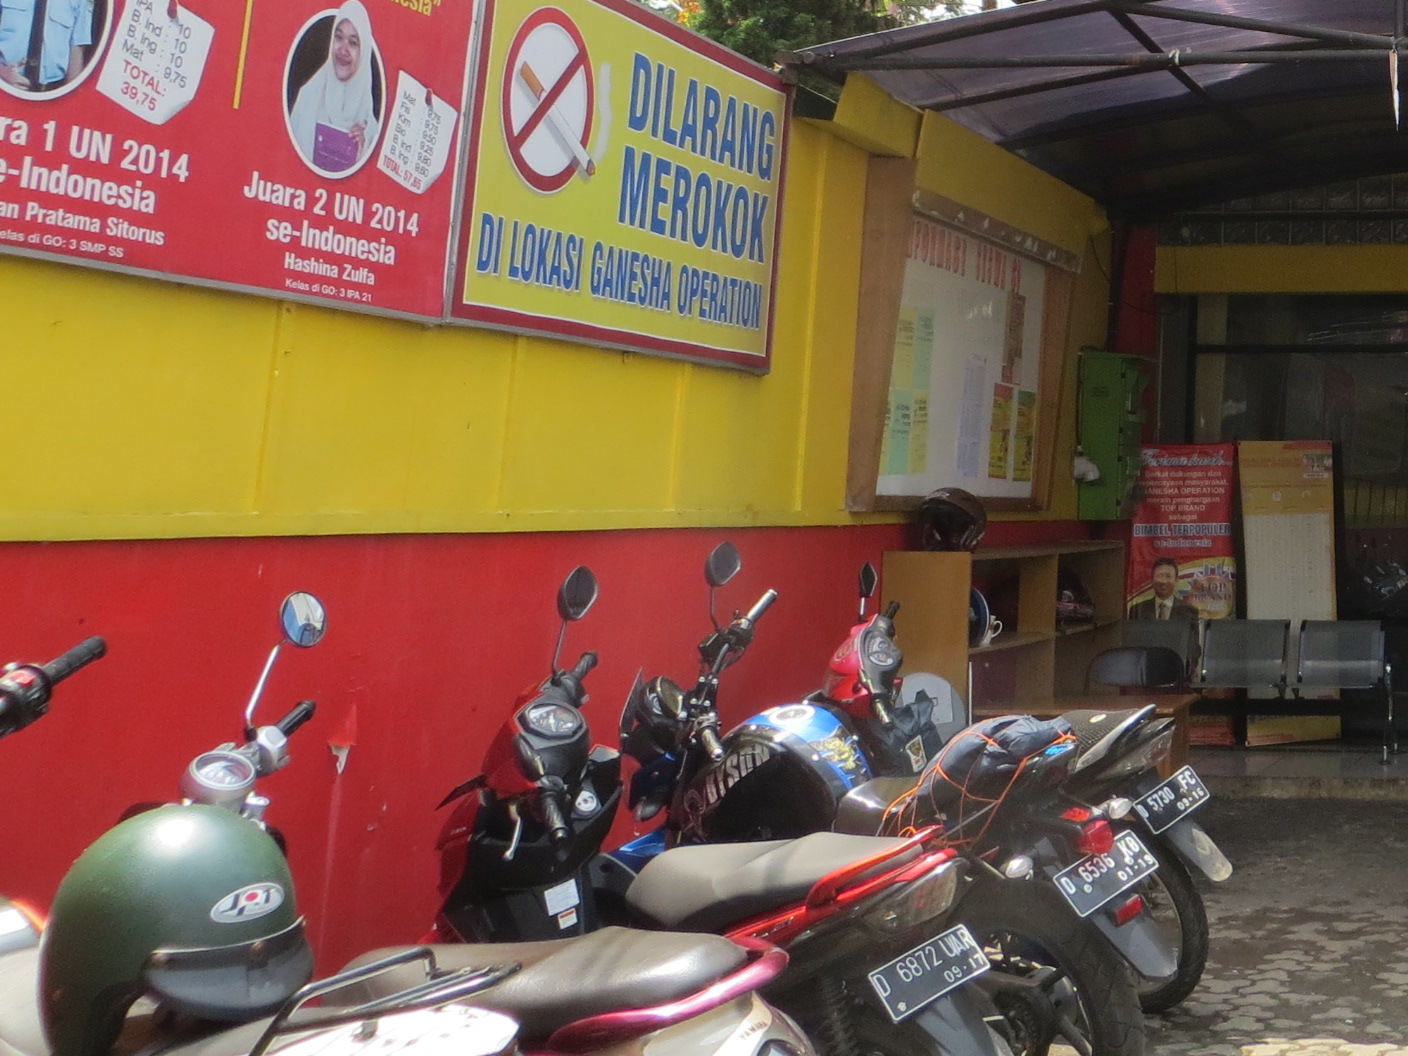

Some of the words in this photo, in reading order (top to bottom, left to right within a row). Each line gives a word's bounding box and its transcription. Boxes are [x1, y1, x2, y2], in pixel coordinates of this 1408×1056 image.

[121, 81, 157, 111] 39,75
[123, 59, 167, 97] TOTAL:
[627, 50, 775, 182] DILARANG
[43, 121, 56, 151] 1
[69, 125, 114, 164] UN
[120, 139, 190, 183] 2014
[244, 171, 306, 210] Juara
[313, 188, 328, 216] 2
[334, 192, 364, 224] UN
[370, 203, 419, 237] 2014
[618, 145, 769, 263] MEROKOK
[266, 219, 395, 265] se-Indonesia
[284, 252, 339, 278] Hashina
[342, 264, 375, 286] Zulfa
[477, 212, 504, 275] DI
[509, 220, 584, 292] LOKASI
[591, 242, 671, 312] GANESHA
[677, 264, 763, 330] OPERATION
[1060, 877, 1076, 894] D
[1078, 853, 1115, 883] 6536
[873, 974, 891, 998] D
[896, 946, 942, 983] 6872
